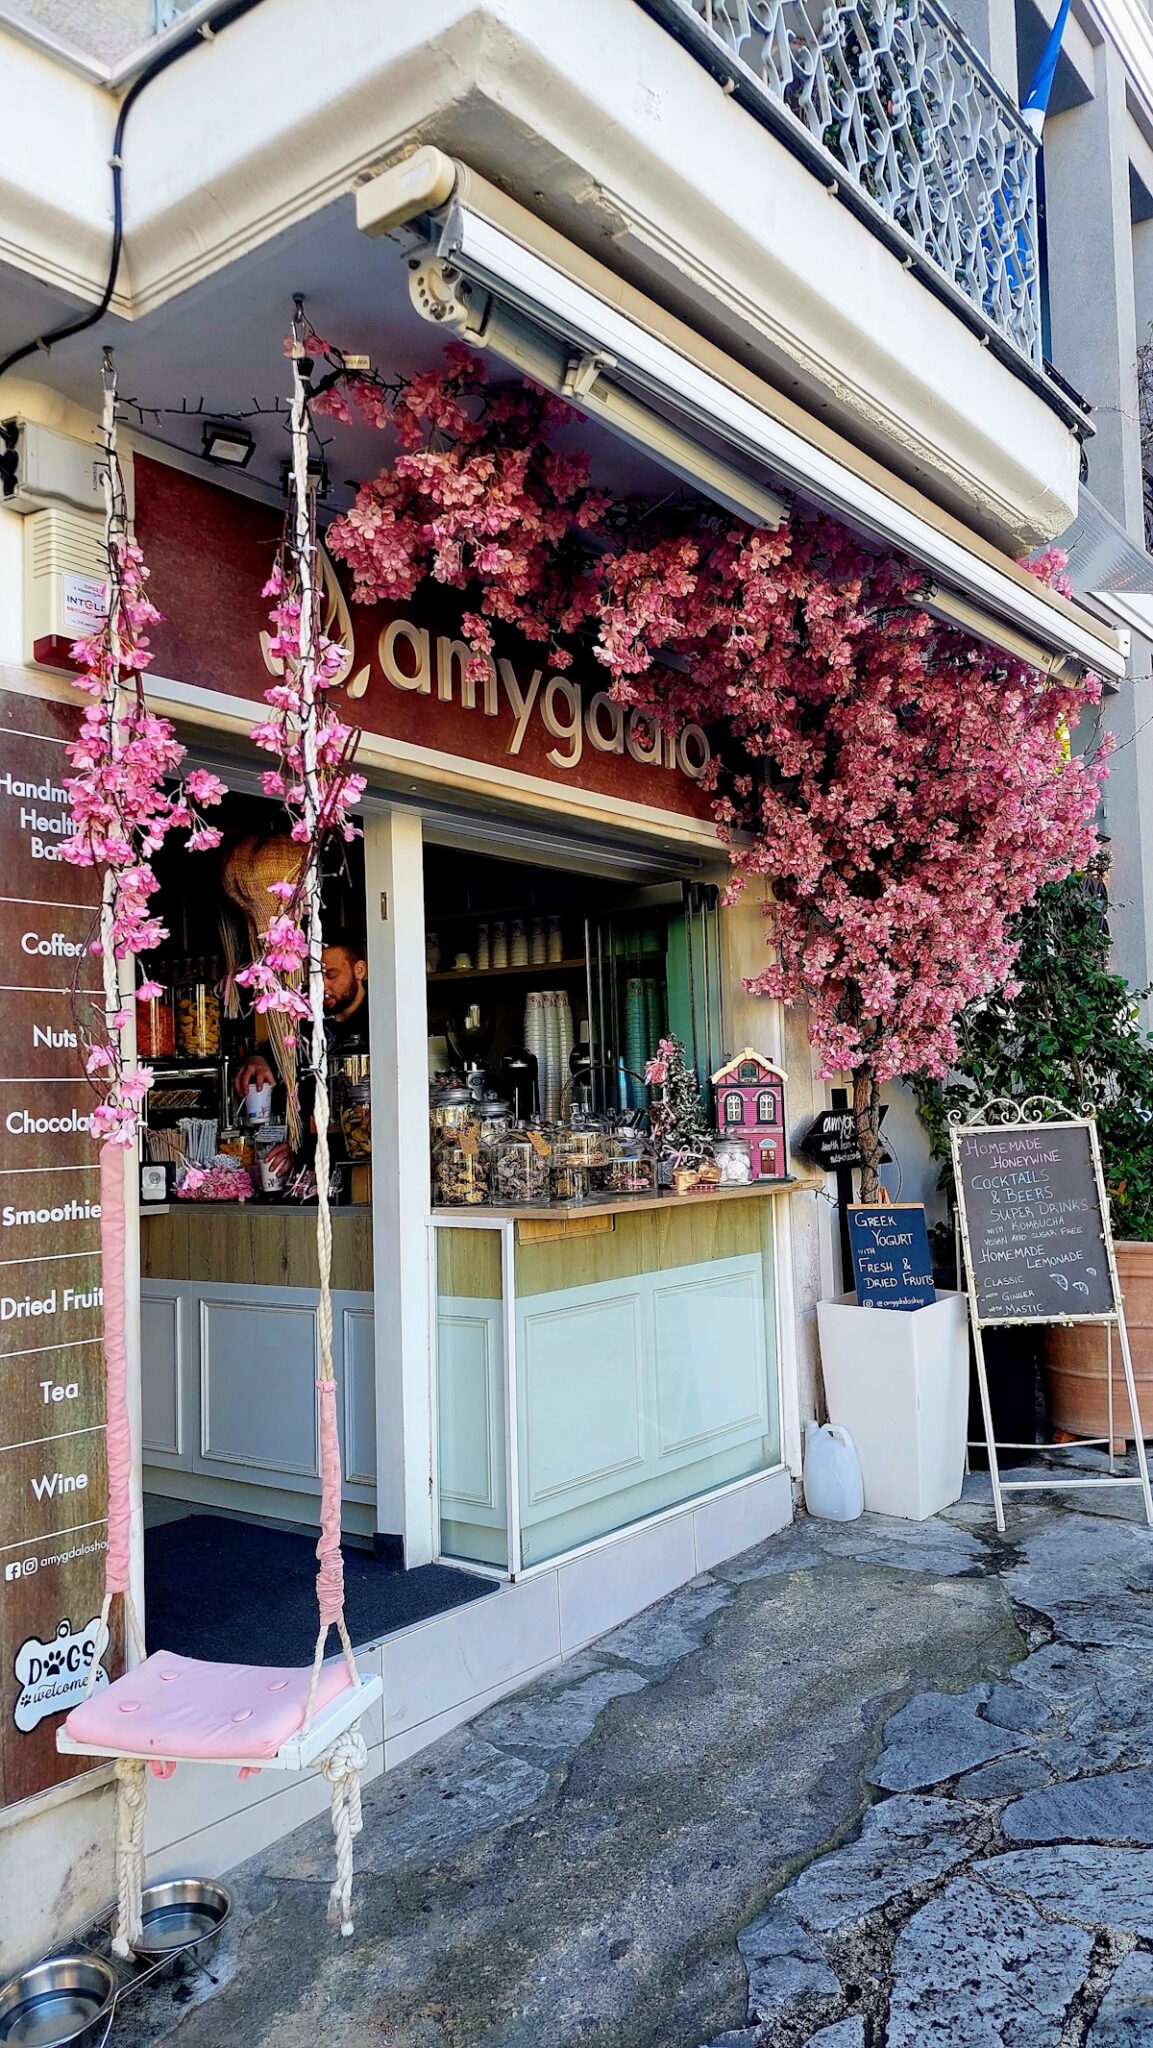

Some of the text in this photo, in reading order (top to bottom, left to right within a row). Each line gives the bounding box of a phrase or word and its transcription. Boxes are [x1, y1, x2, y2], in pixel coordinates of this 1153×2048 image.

[21, 932, 87, 957] Coffee
[33, 1024, 78, 1048] Nuts
[964, 1138, 1042, 1157] HOMEMADE
[990, 1150, 1061, 1169] HONEYWINE
[971, 1169, 1050, 1190] COCKTAILS
[991, 1186, 1054, 1204] & BEERS
[2, 1199, 102, 1226] Smoothie
[855, 1212, 897, 1227] GREEK
[990, 1199, 1089, 1222] SUPER DRINKS
[987, 1217, 1065, 1235] WITH KOMBUCHA
[871, 1229, 913, 1246] YOGURT
[983, 1227, 1083, 1247] VEGAN AND SUGAR FREE
[978, 1243, 1046, 1264] HOMEMADE
[1026, 1249, 1084, 1269] LEMONADE
[858, 1257, 912, 1273] FRESH &
[863, 1271, 935, 1289] DRIED FRUITS
[983, 1275, 1025, 1288] CLASSIC
[0, 1289, 56, 1320] Dried
[1002, 1289, 1035, 1301] GINGER
[1003, 1303, 1044, 1316] MASTIC
[40, 1380, 79, 1404] Tea
[30, 1473, 89, 1501] Wine
[33, 1676, 88, 1703] welcome
